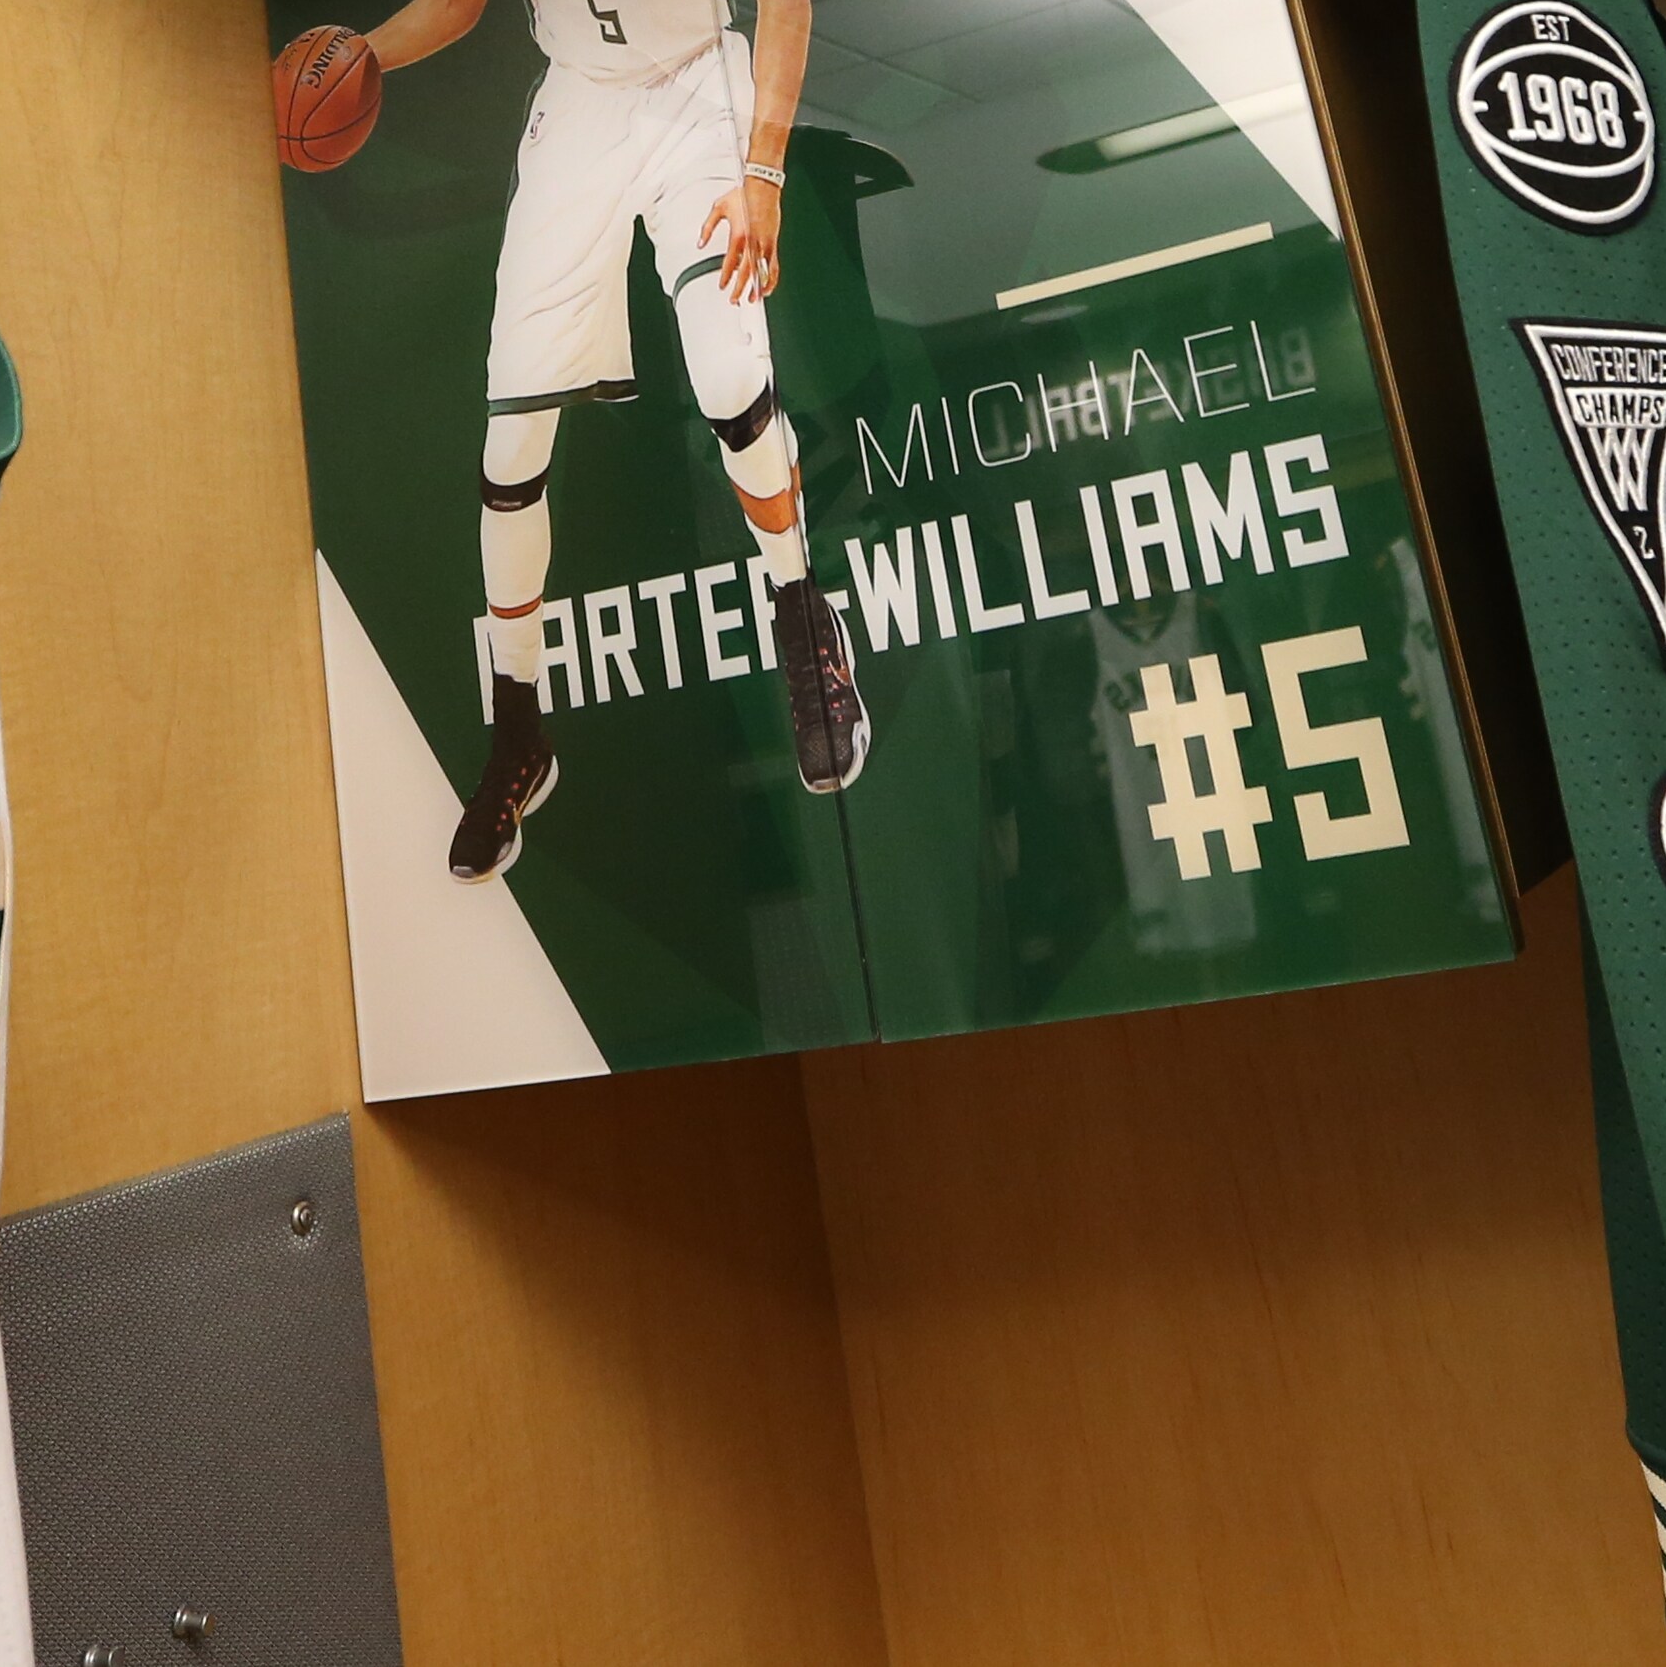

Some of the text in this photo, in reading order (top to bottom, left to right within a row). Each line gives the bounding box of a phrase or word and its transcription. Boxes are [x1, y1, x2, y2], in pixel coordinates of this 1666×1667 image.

[1531, 14, 1571, 41] EST
[1497, 71, 1627, 150] 1968
[855, 320, 1317, 495] MICHAEL
[1576, 393, 1665, 424] CHAMPS
[1128, 625, 1411, 881] #5
